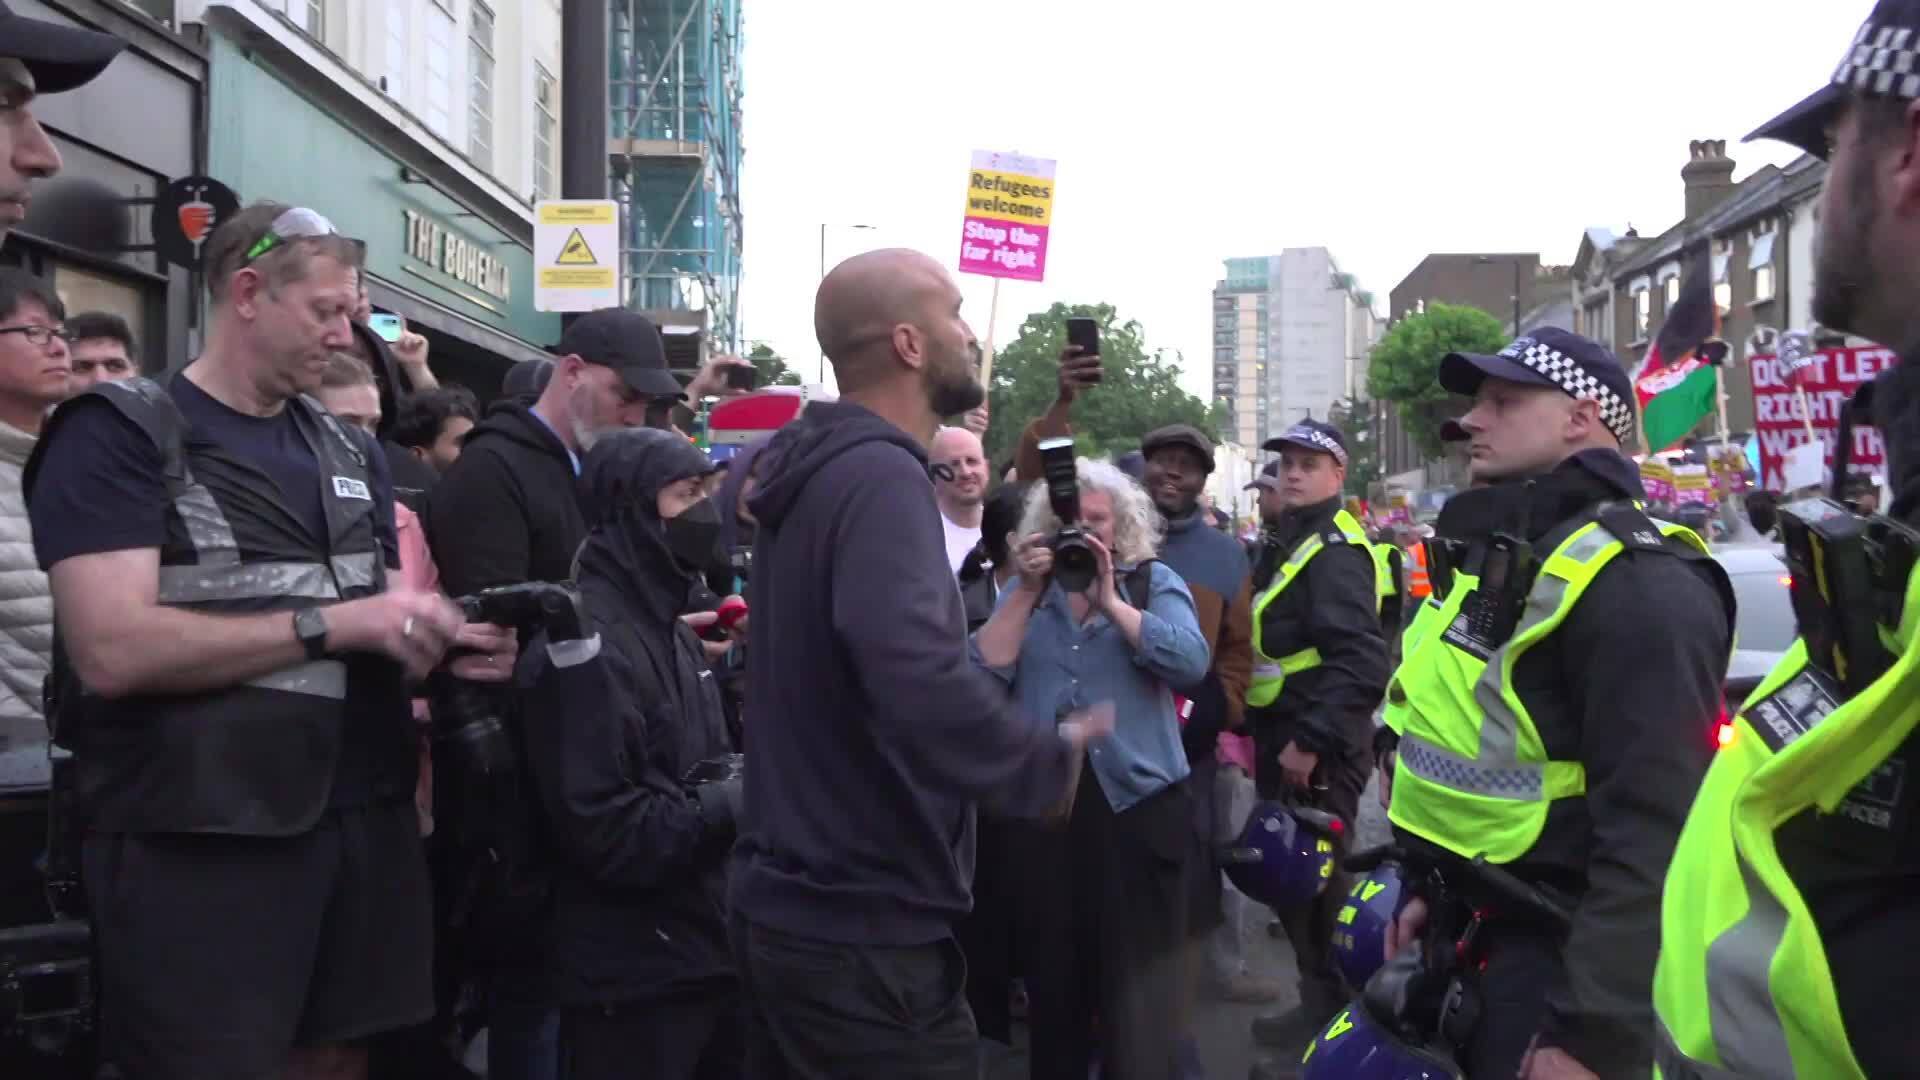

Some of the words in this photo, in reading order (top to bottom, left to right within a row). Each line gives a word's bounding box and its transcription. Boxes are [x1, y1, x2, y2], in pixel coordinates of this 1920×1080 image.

[971, 173, 1050, 198] Refugees
[970, 196, 1044, 218] welcome
[402, 209, 439, 267] THE
[965, 221, 1007, 245] Stop
[1009, 227, 1040, 246] the
[963, 241, 990, 260] far
[992, 246, 1037, 269] right
[1752, 355, 1828, 387] DOT
[1835, 350, 1894, 381] LET
[1756, 391, 1842, 422] RIGHT
